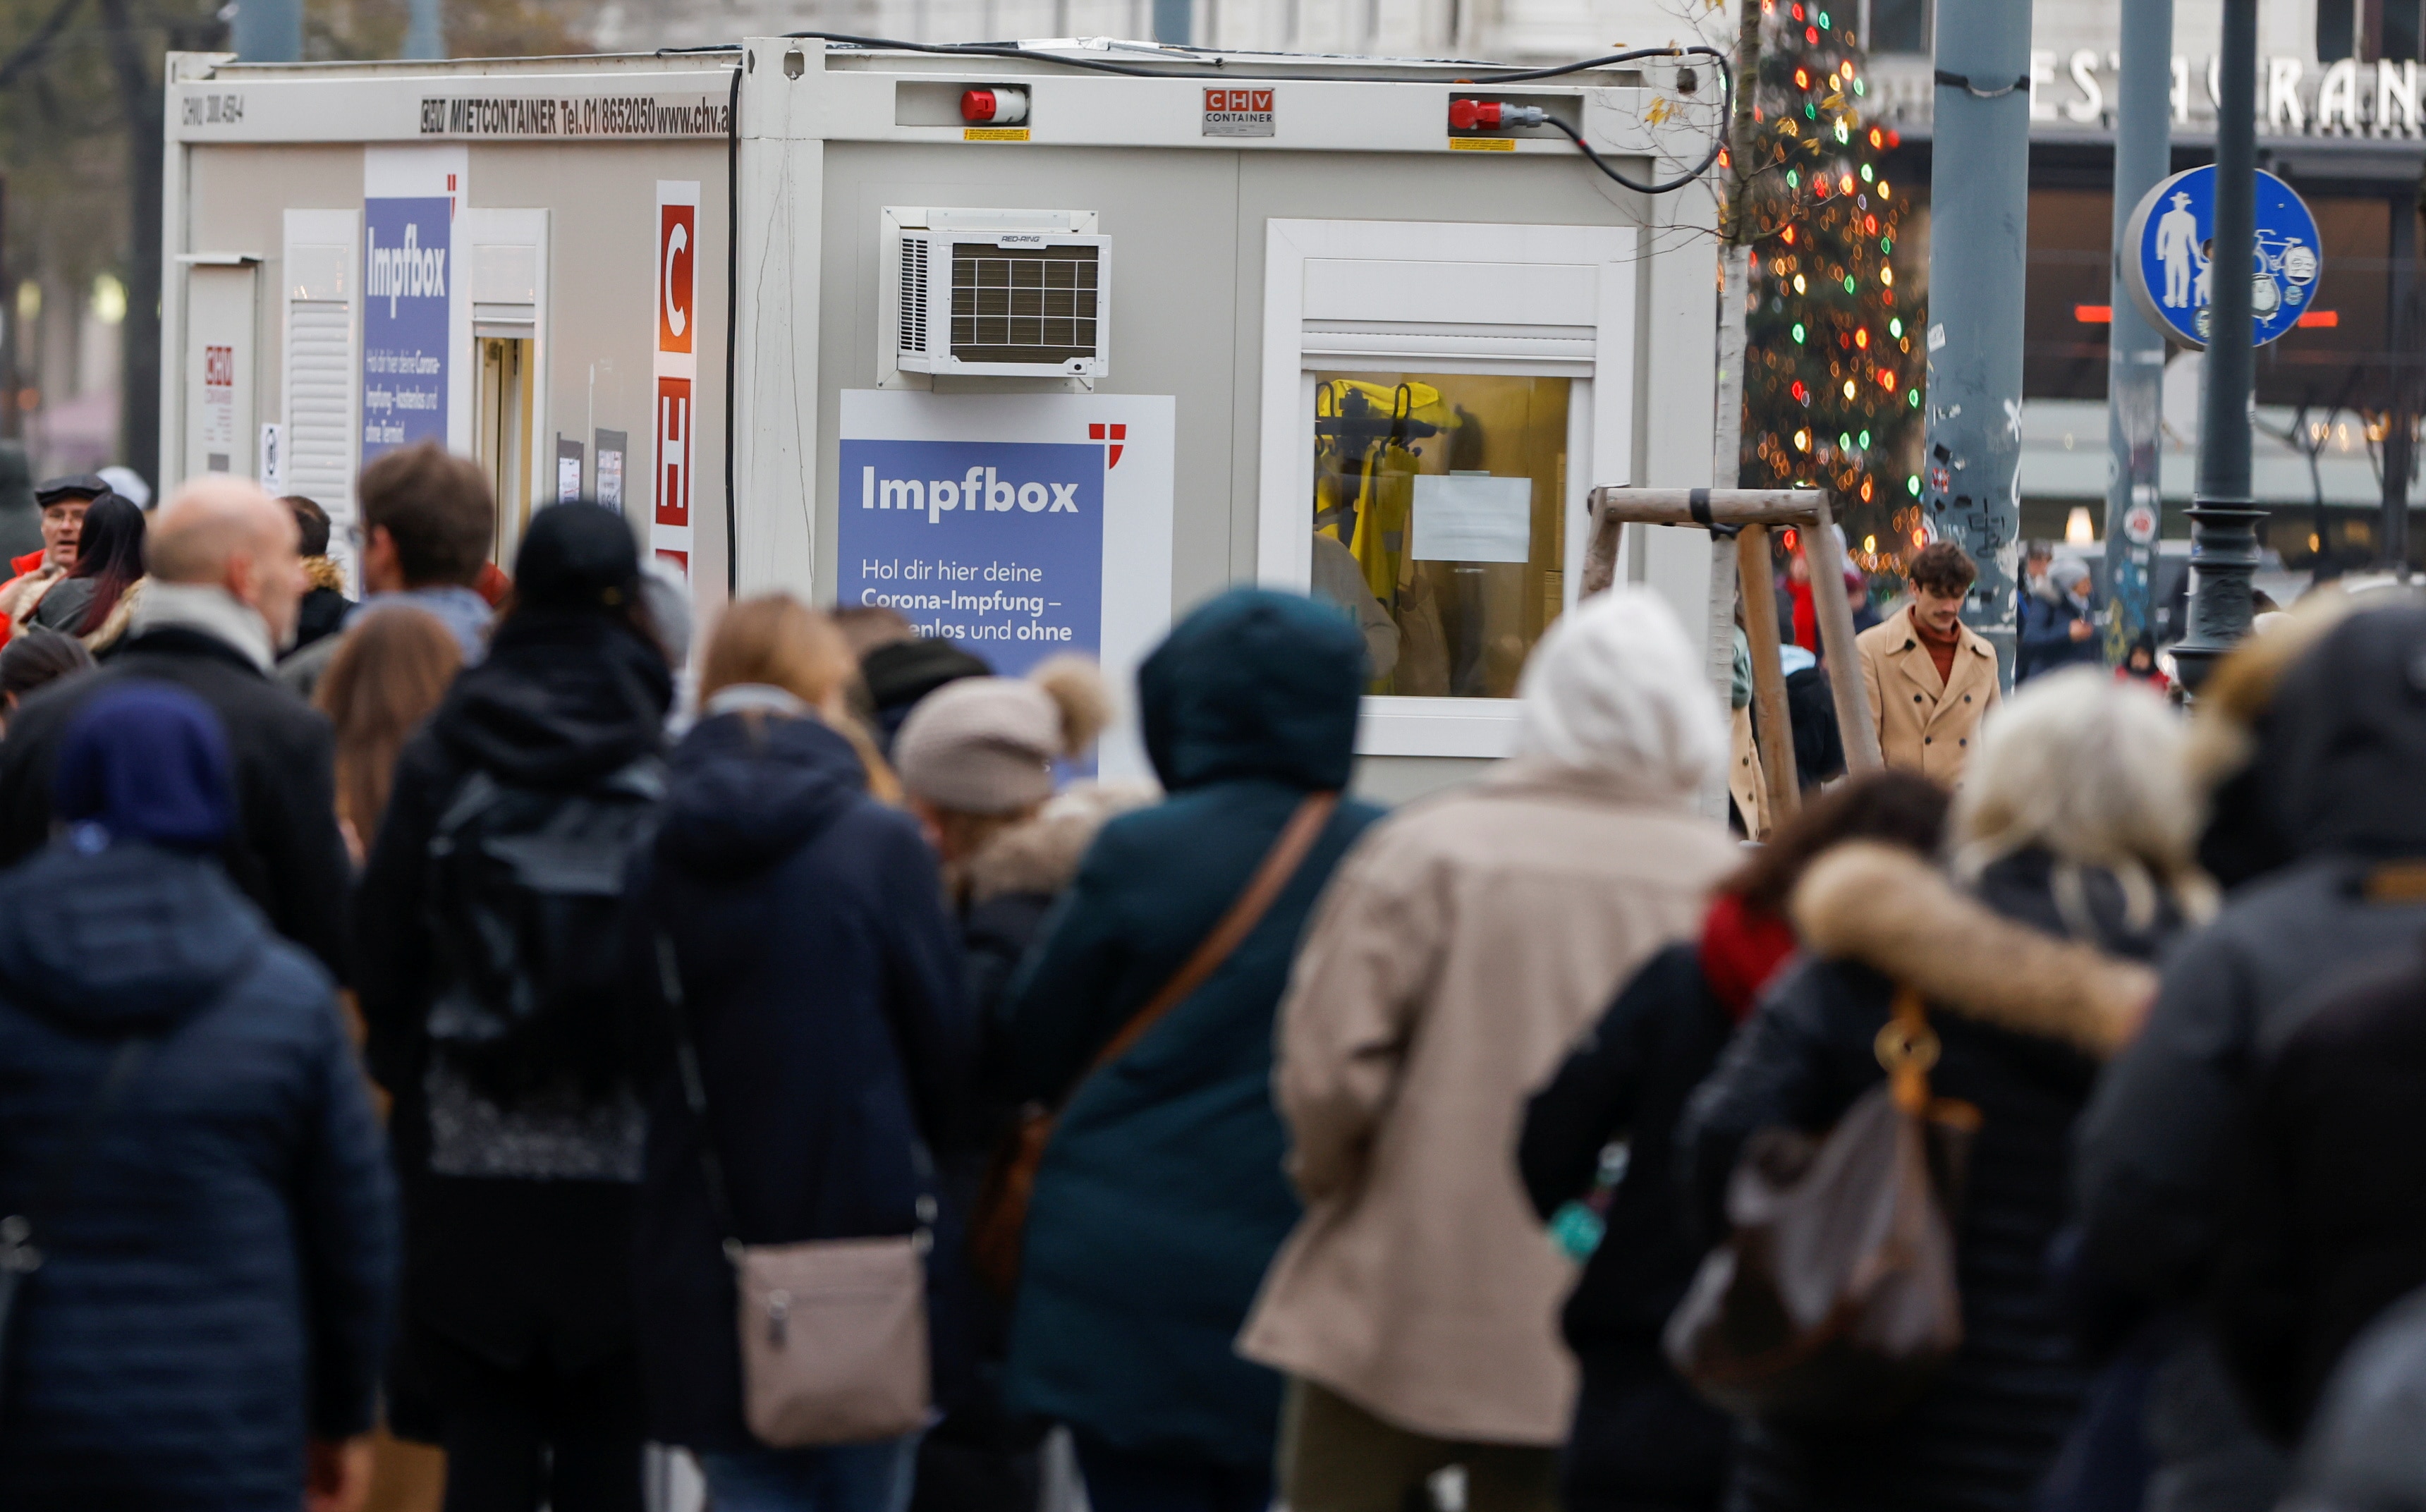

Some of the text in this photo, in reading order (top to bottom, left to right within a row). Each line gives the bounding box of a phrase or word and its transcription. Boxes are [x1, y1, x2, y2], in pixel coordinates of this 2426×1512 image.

[1208, 92, 1271, 109] CHV
[450, 99, 556, 134] MIETCONTAINER
[657, 97, 729, 133] www.chv.a
[1206, 114, 1272, 122] CONTAINER
[367, 223, 446, 319] Impfbox
[862, 465, 1078, 523] Impfbox
[862, 559, 1042, 582] Hol dir hier deine
[861, 588, 1044, 617] Corona-Impfung
[908, 618, 1072, 641] enlos und ohne
